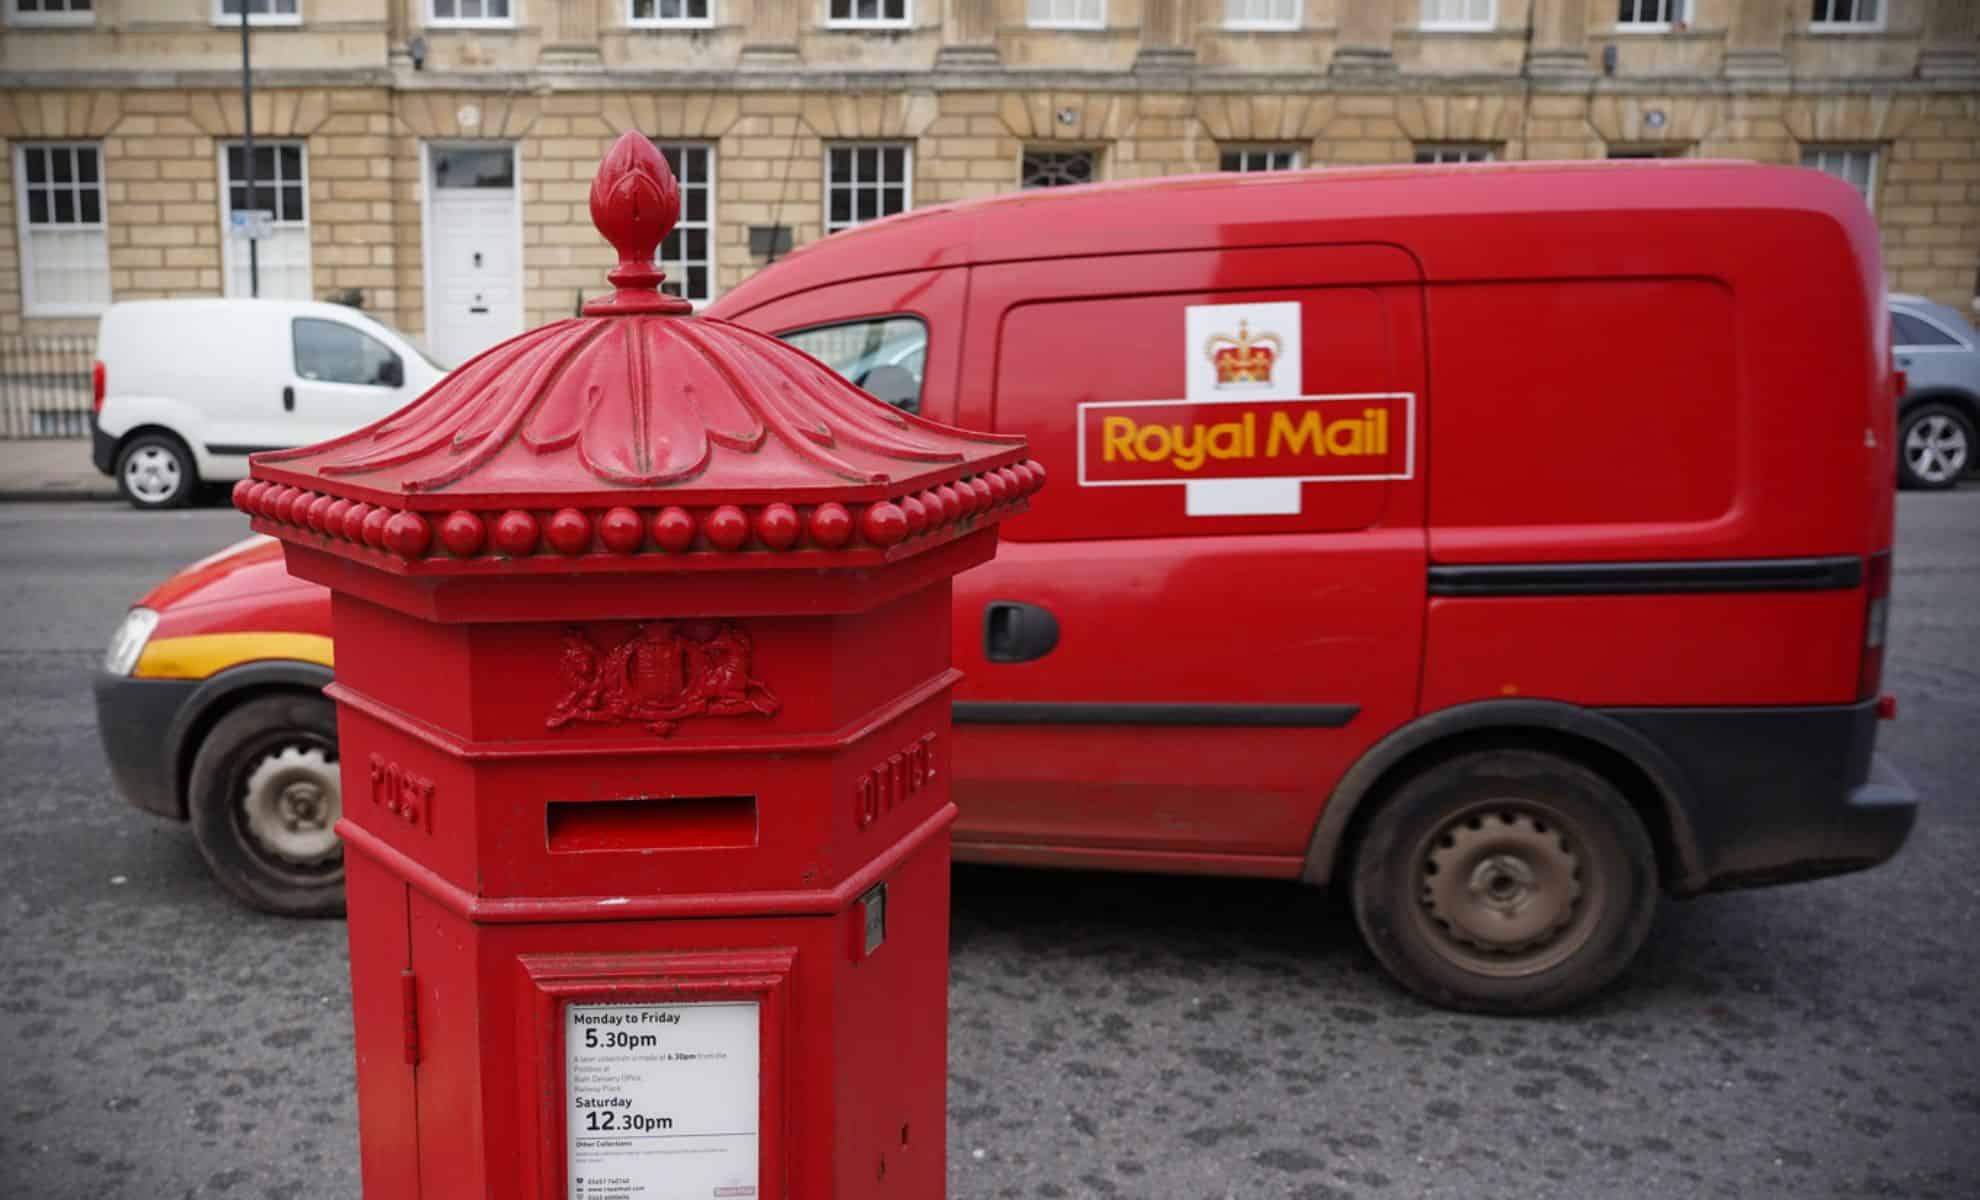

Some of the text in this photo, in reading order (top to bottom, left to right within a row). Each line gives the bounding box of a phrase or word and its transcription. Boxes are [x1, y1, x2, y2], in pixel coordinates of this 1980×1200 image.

[1103, 408, 1388, 471] Royal Mail
[855, 731, 937, 833] OFFICE
[368, 752, 436, 837] POST
[574, 1012, 681, 1026] Monday to Friday
[585, 1027, 658, 1050] 5.30pm
[575, 1096, 633, 1109] Saturday
[586, 1111, 673, 1132] 12.30pm
